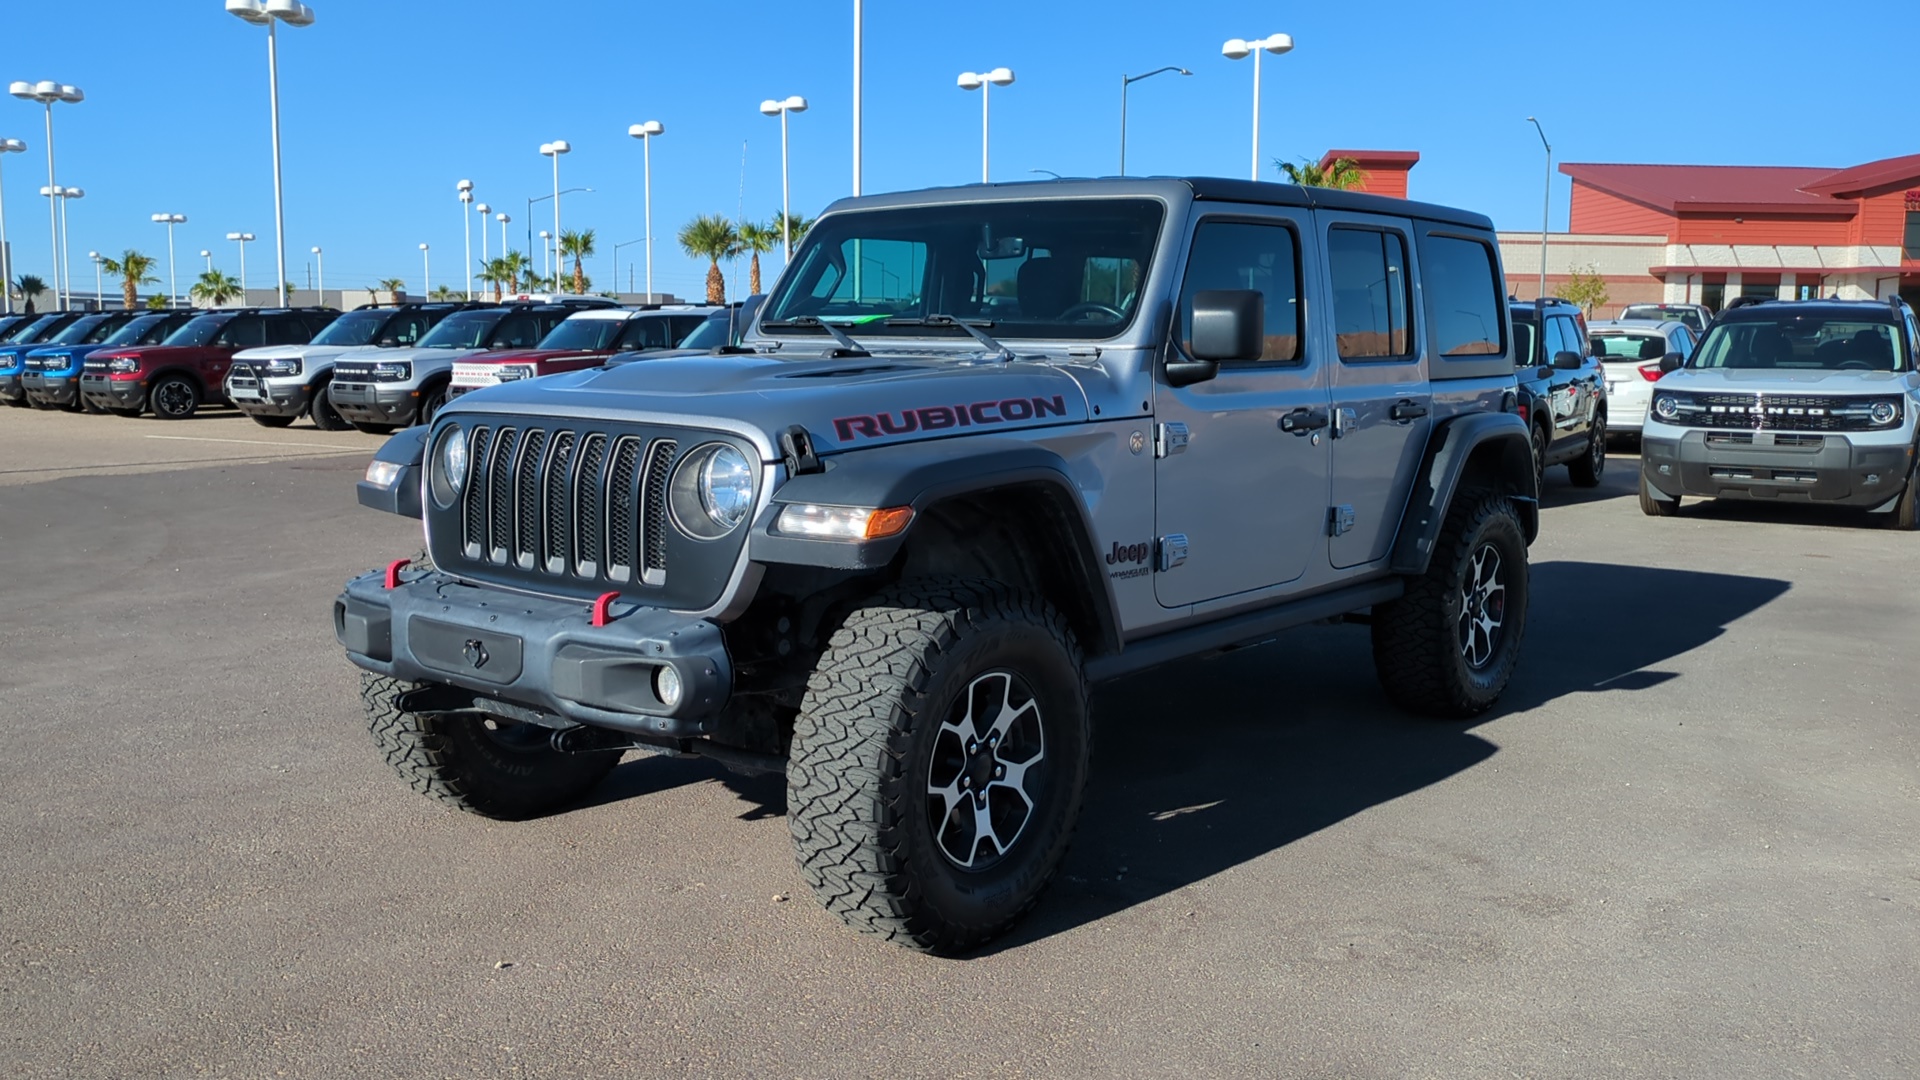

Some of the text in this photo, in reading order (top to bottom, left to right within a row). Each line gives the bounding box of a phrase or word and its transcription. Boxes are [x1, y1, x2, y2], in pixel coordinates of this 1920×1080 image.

[832, 395, 1067, 442] RUBICON
[1710, 405, 1825, 416] BRONCO
[1106, 541, 1149, 565] Jeep
[1110, 567, 1149, 579] WRANGLER
